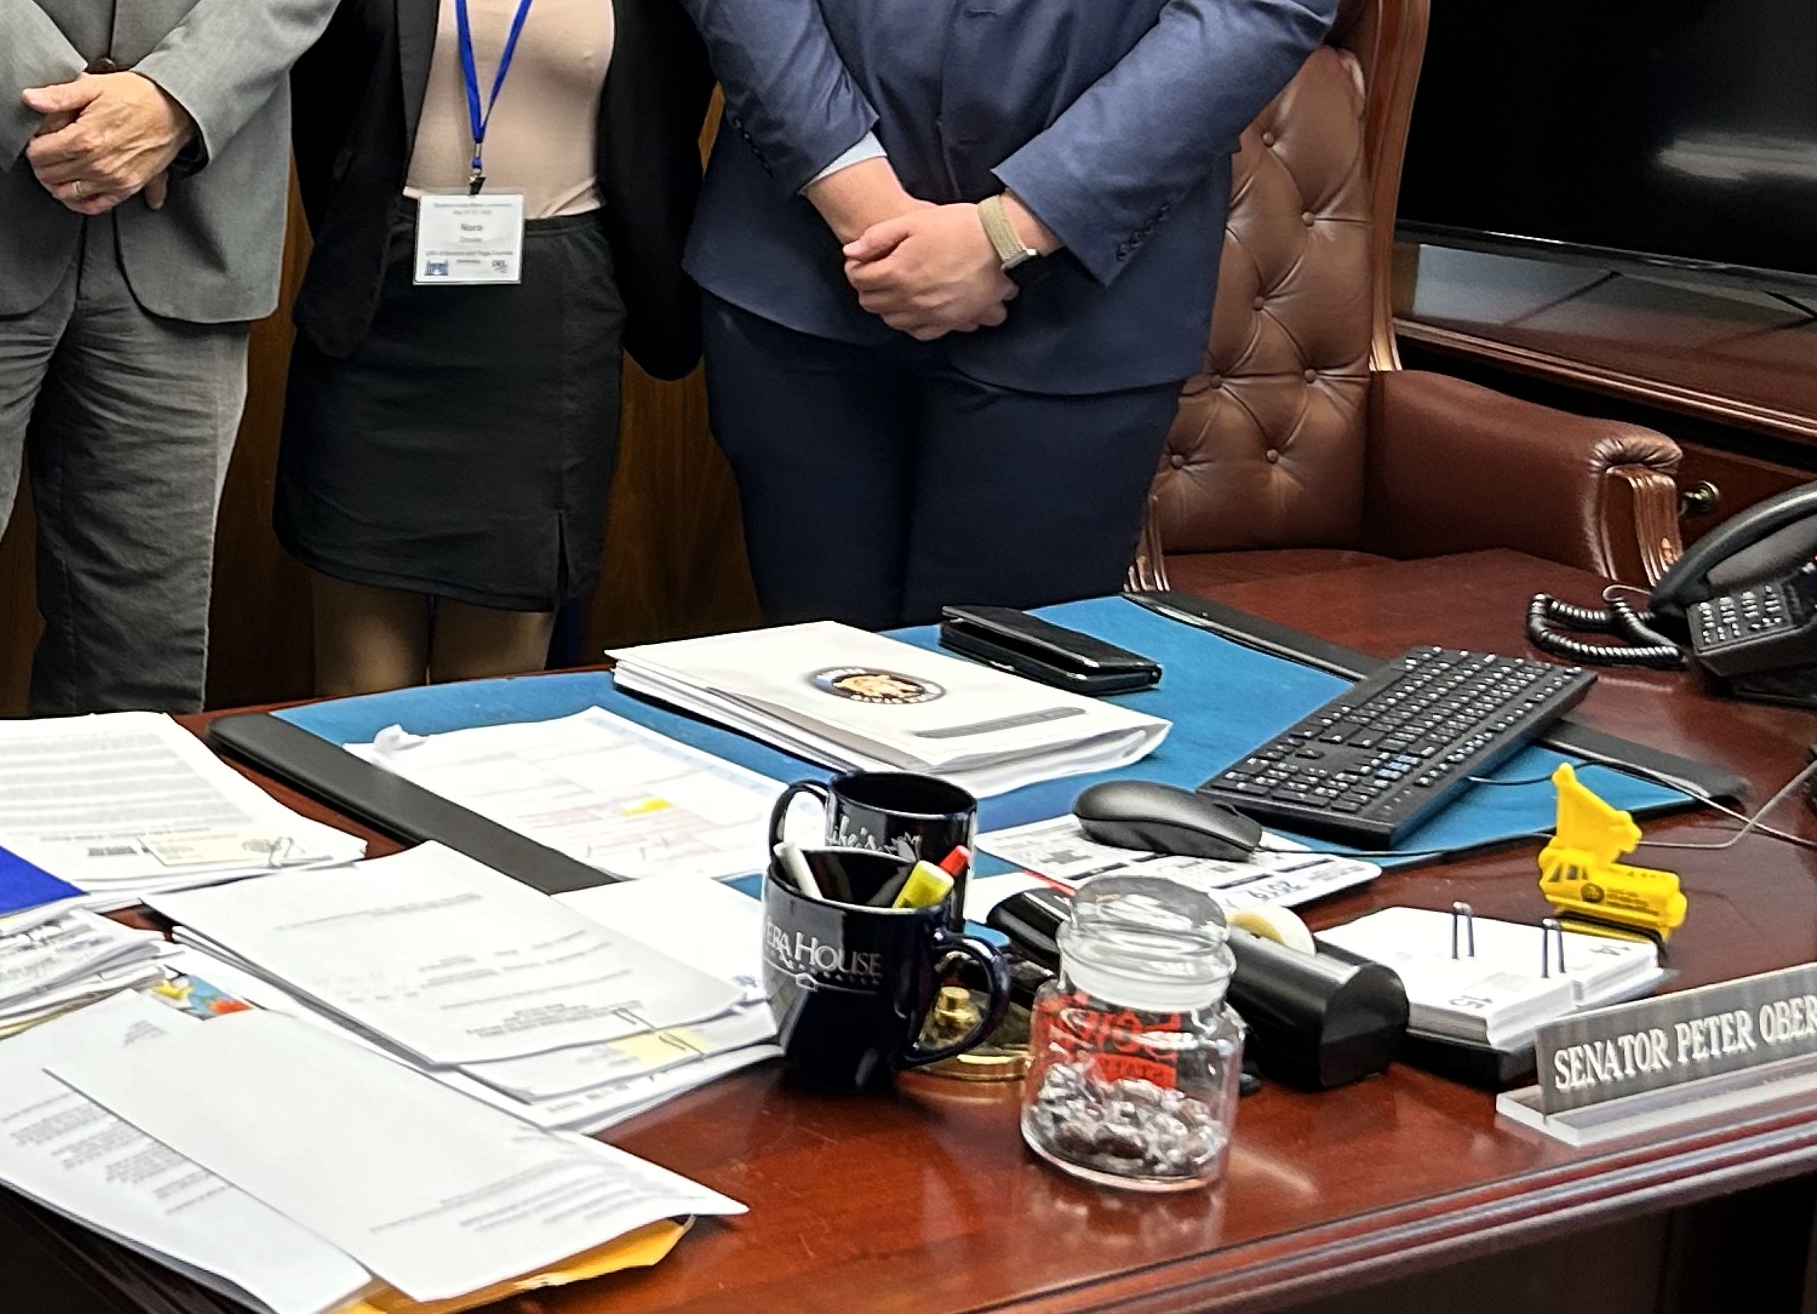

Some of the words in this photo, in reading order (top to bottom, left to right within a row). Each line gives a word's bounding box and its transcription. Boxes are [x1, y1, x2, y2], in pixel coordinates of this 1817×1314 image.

[794, 931, 884, 978] HOUSE
[1553, 1028, 1672, 1091] SENATOR
[1674, 1010, 1757, 1065] PETER
